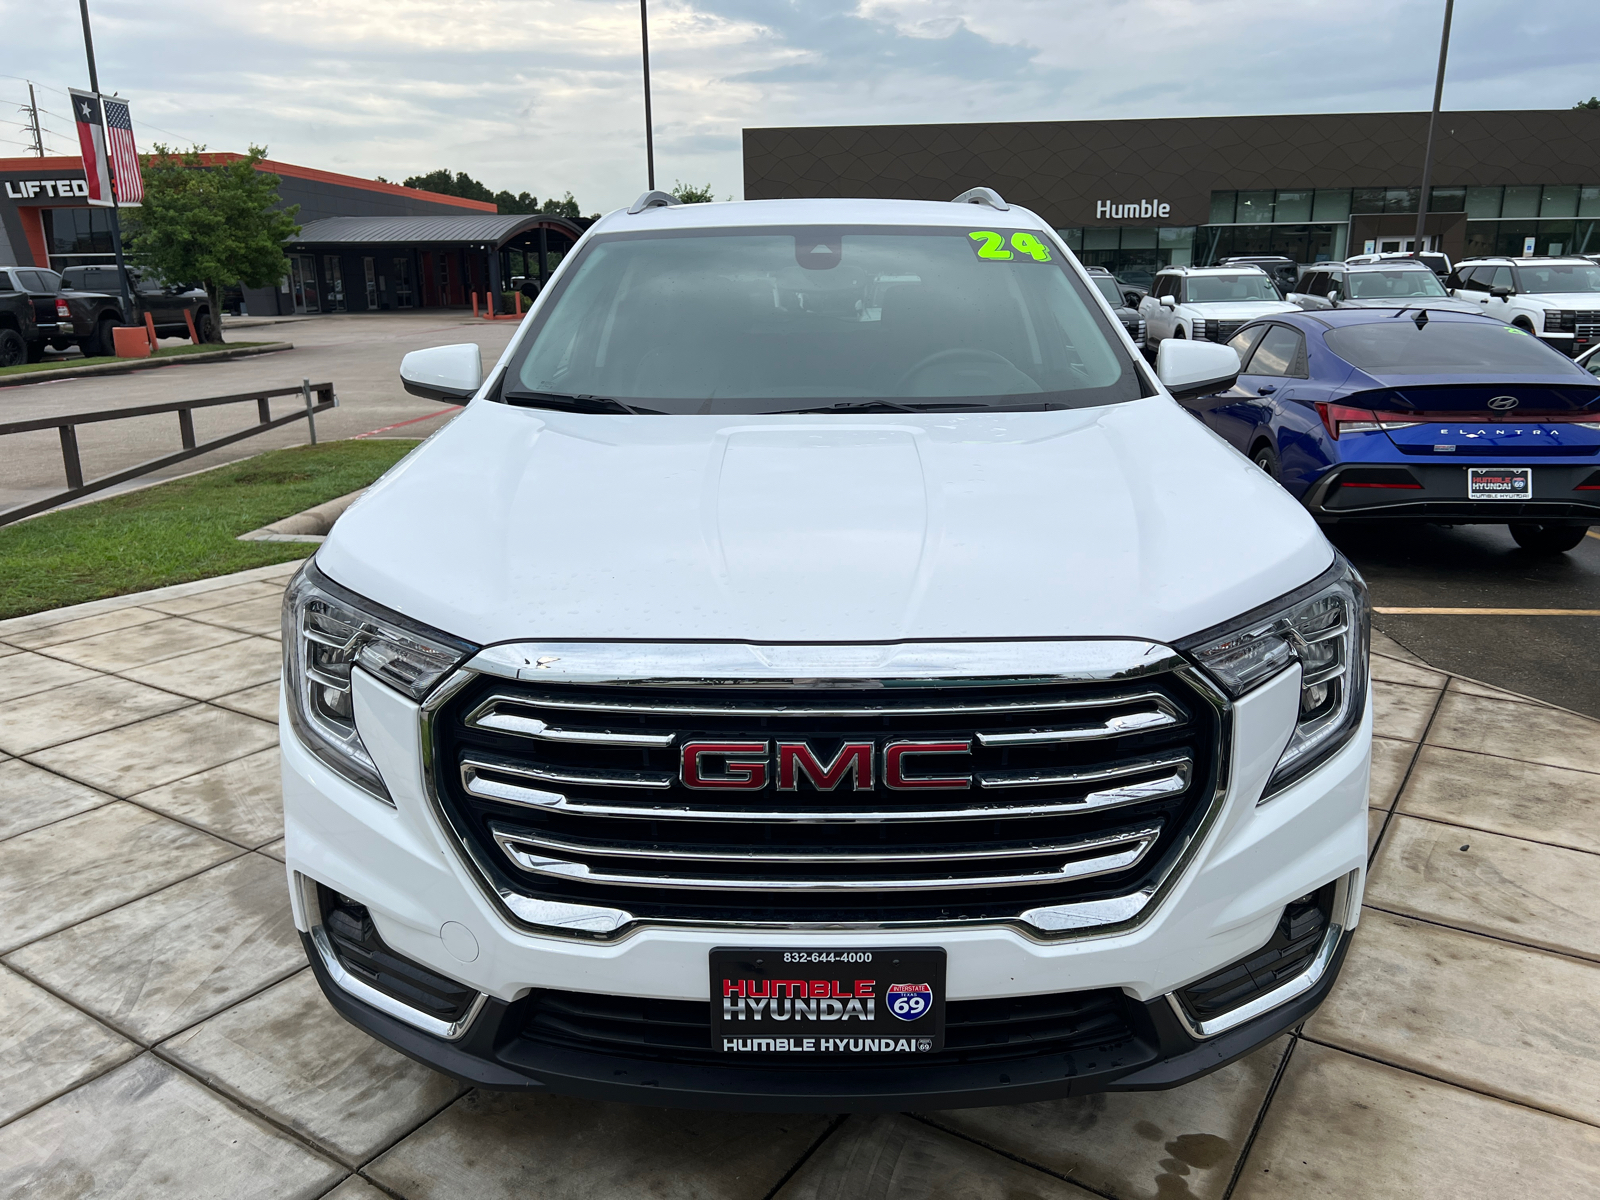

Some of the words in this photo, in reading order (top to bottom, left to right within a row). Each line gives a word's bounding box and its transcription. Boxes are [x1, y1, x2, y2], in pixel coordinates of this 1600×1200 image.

[5, 180, 89, 198] LIFTED
[1096, 199, 1171, 219] Humble
[968, 230, 1052, 262] 24
[680, 740, 972, 791] GMC
[783, 952, 873, 963] 832-644-4000
[723, 979, 876, 998] HUMBLE
[723, 998, 876, 1021] HYUNDAI
[893, 997, 925, 1014] 69
[723, 1039, 816, 1052] HUMBLE
[820, 1039, 917, 1052] HYUNDAI
